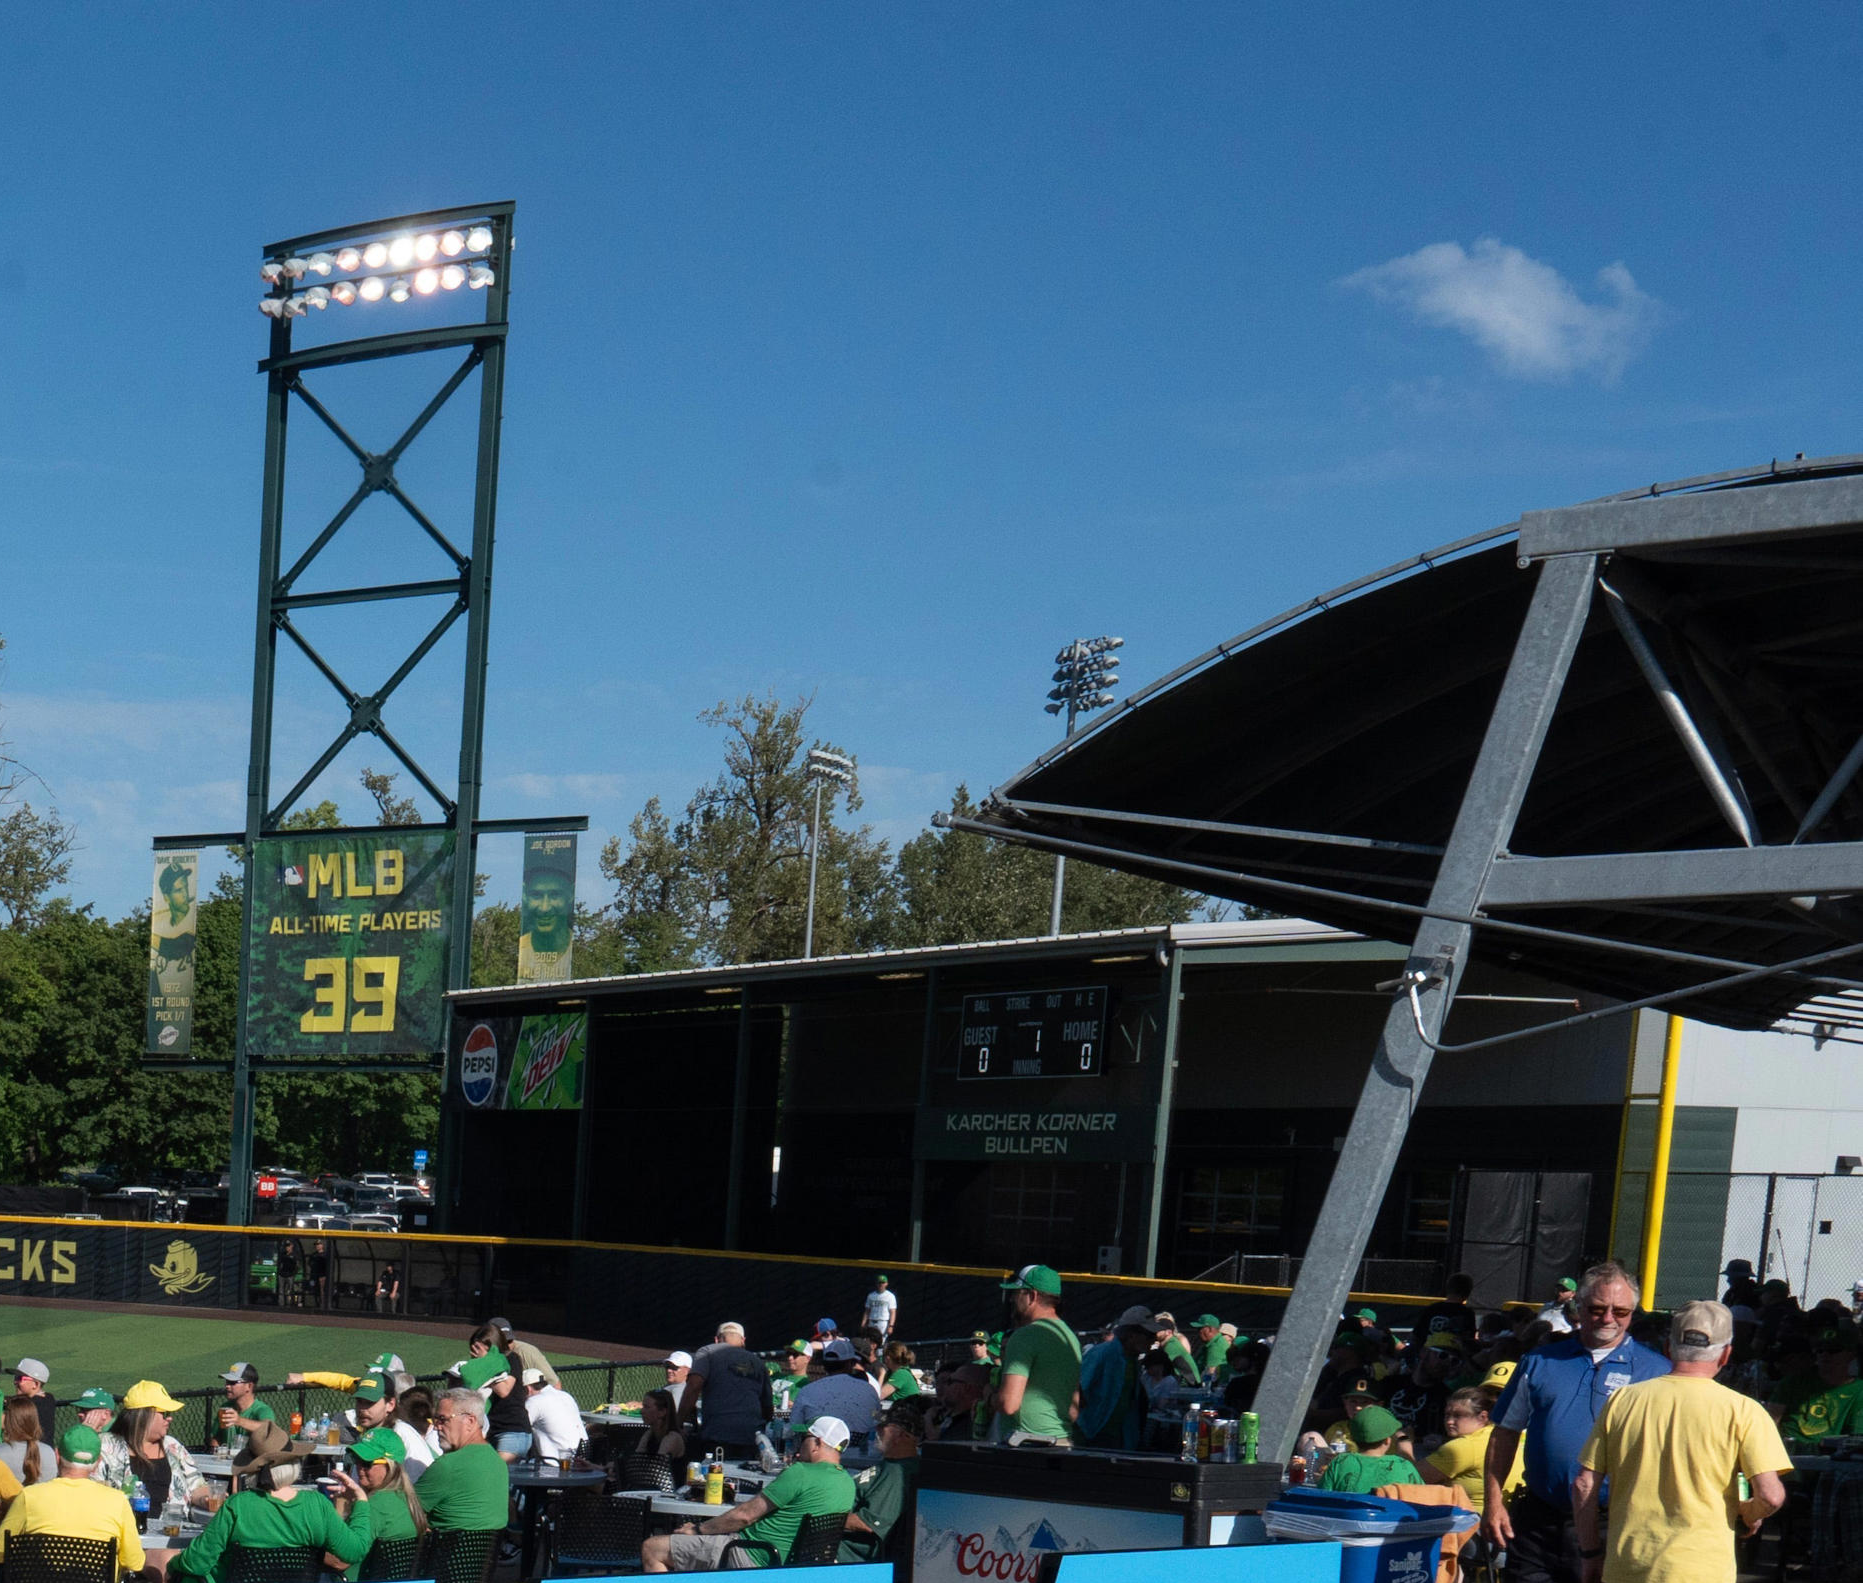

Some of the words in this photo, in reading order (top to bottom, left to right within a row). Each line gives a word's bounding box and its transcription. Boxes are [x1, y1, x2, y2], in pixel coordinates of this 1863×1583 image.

[307, 849, 404, 898] MLB
[269, 914, 352, 935] ALL-TIME
[359, 909, 442, 932] PLAYERS
[300, 956, 401, 1033] 39
[974, 1000, 990, 1012] BALL
[1006, 997, 1031, 1010] STRIKE
[1046, 994, 1063, 1008] OUT
[1075, 992, 1082, 1005] H
[1088, 992, 1095, 1005] E
[156, 1010, 174, 1021] PICK
[964, 1026, 999, 1046] GUEST
[1063, 1021, 1099, 1041] HOME
[464, 1056, 495, 1073] PEPSI
[978, 1047, 989, 1073] 0
[1080, 1043, 1092, 1070] 0
[1012, 1059, 1042, 1075] INNING
[946, 1113, 1031, 1131] KARCHER
[1035, 1113, 1117, 1131] KORNER
[985, 1136, 1068, 1154] BULLPEN
